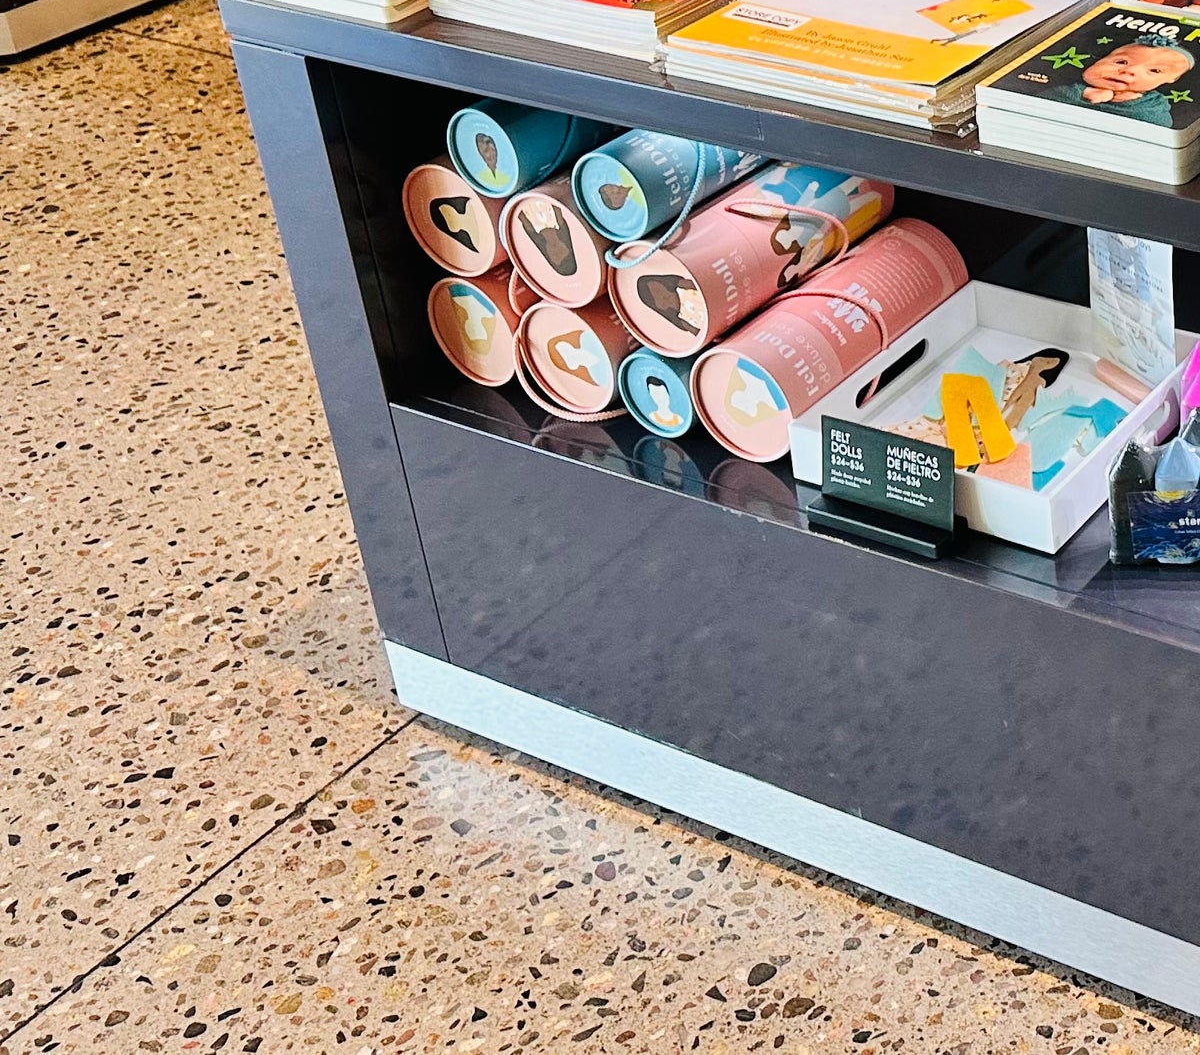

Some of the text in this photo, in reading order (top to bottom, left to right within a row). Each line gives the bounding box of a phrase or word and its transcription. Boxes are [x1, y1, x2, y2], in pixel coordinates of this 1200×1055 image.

[736, 6, 802, 26] STORE COPY
[752, 331, 819, 397] Felt Doll
[830, 428, 851, 445] FELT
[831, 441, 863, 460] DOLLS
[886, 444, 939, 469] MUÑECAS
[886, 456, 901, 471] DE
